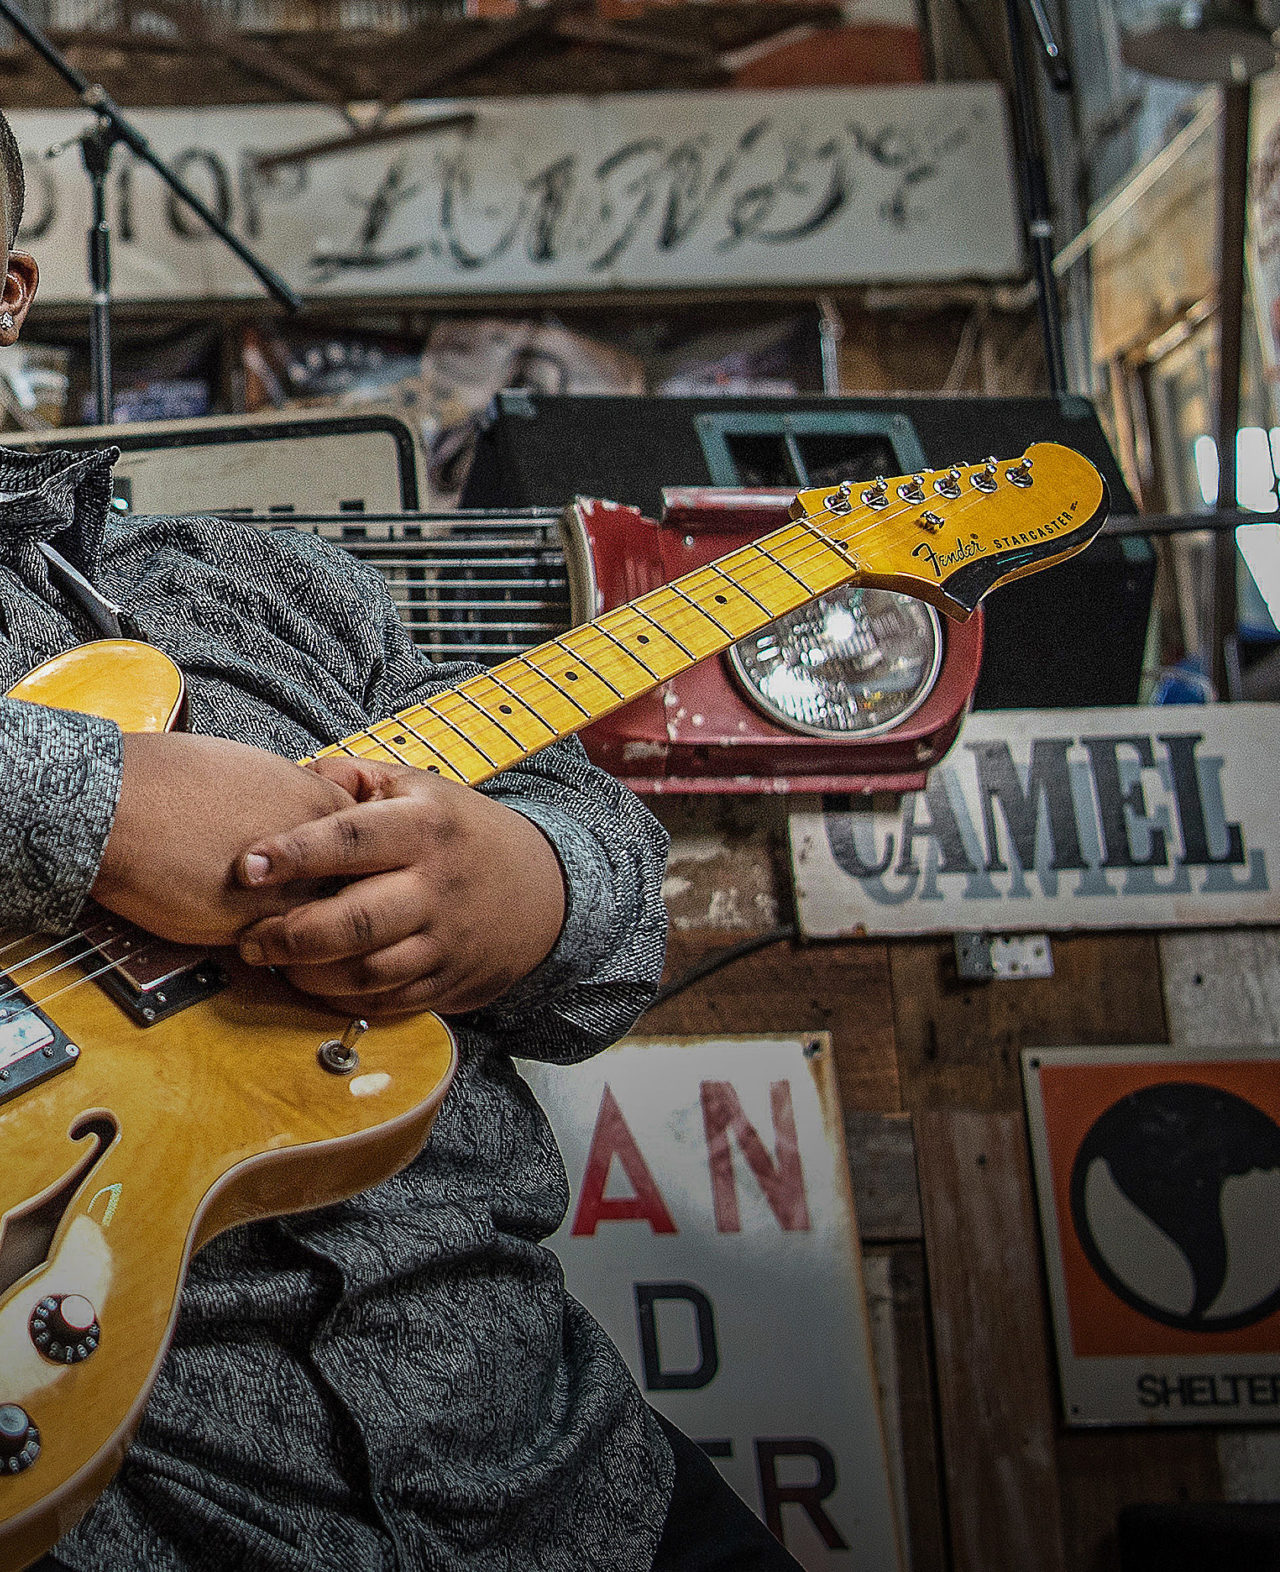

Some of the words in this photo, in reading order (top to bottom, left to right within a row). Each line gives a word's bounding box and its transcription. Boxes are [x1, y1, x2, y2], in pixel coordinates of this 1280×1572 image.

[911, 534, 987, 598] Fender
[993, 510, 1073, 549] STARCASTER
[822, 733, 1246, 880] CAMEL
[633, 1280, 719, 1391] D
